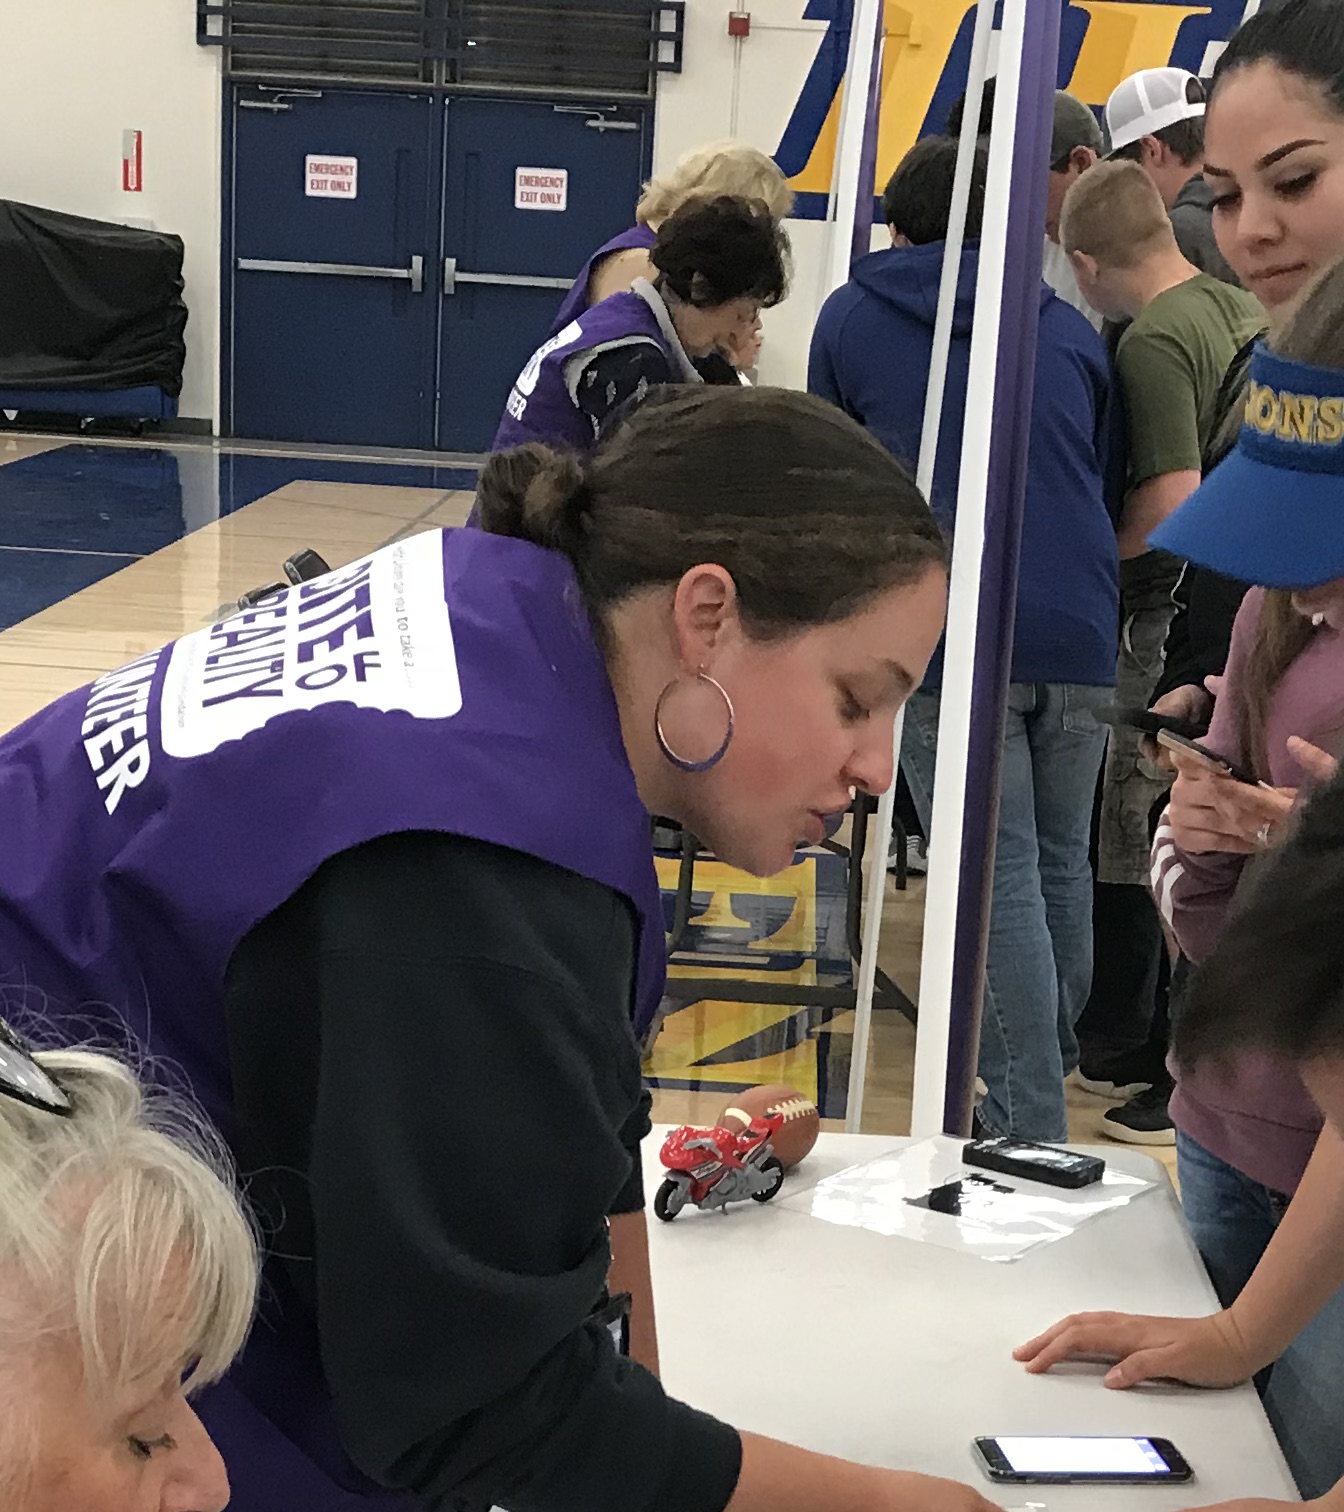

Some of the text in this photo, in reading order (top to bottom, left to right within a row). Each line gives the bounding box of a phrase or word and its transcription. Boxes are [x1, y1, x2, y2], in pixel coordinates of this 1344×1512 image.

[309, 162, 354, 177] EMERGENCY
[310, 178, 353, 193] EXIT ONLY
[519, 174, 564, 190] EMERGENCY
[520, 190, 563, 205] EXIT ONLY
